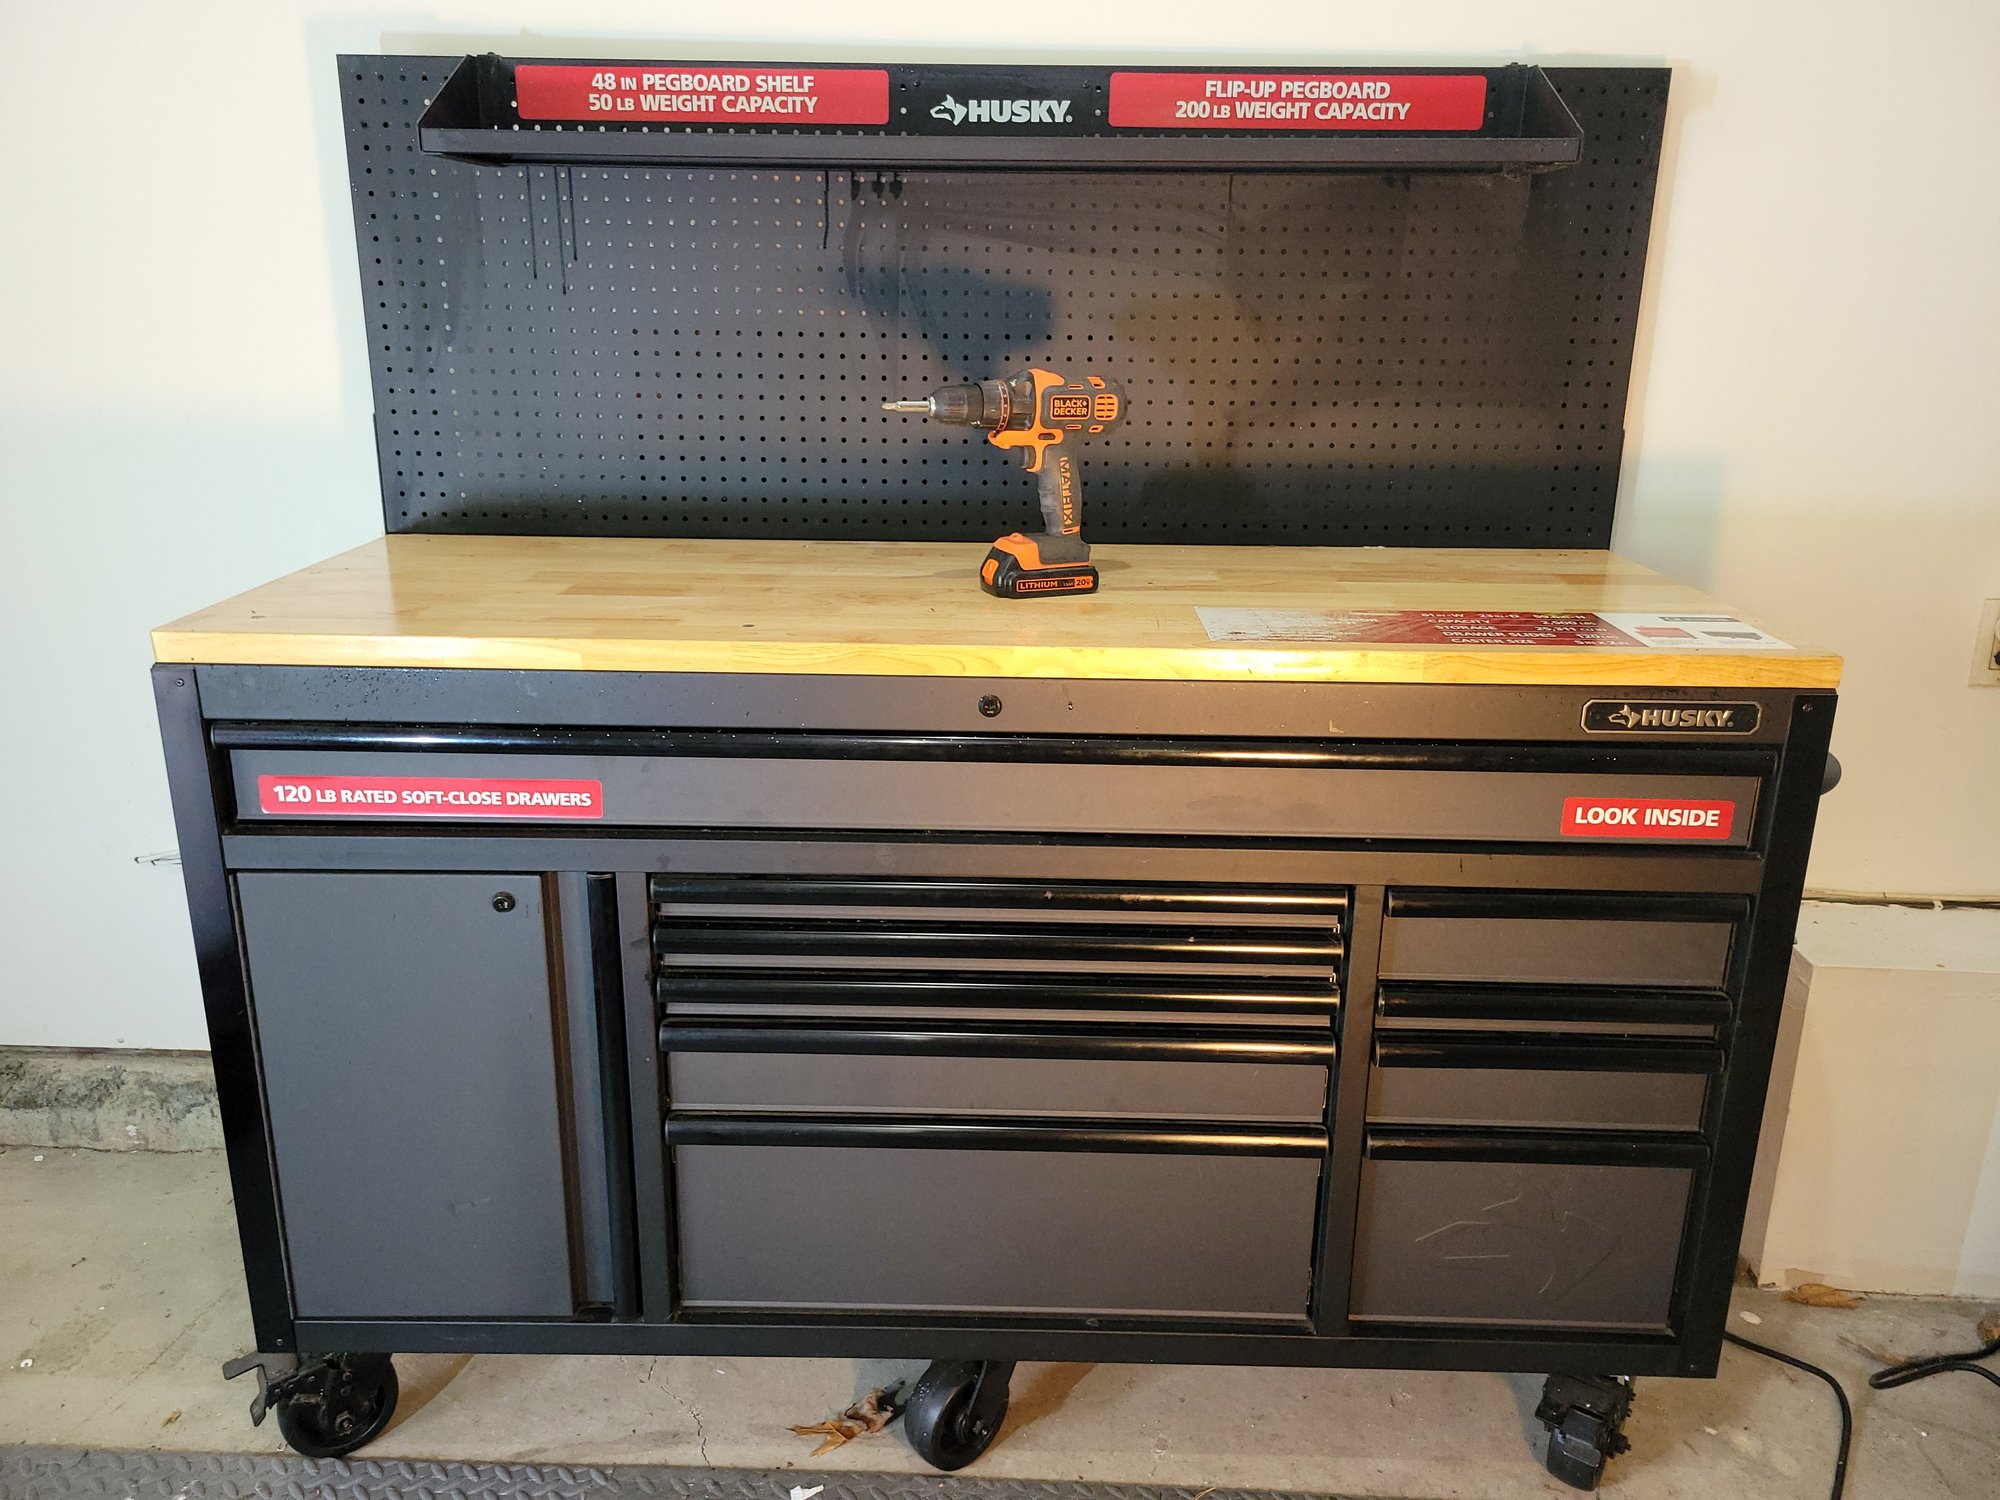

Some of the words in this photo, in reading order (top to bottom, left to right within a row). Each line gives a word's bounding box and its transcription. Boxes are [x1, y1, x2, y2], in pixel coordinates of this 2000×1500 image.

[591, 73, 617, 91] 48
[621, 77, 637, 91] IN
[642, 74, 751, 92] PEGBOARD
[755, 75, 815, 93] SHELF
[1205, 80, 1277, 98] FLIP-UP
[1281, 81, 1391, 100] PEGBOARD
[589, 93, 613, 111] 50
[617, 98, 635, 111] LB
[639, 94, 717, 112] WEIGHT
[722, 96, 818, 114] CAPACITY
[1175, 101, 1211, 118] 200
[1213, 105, 1231, 118] LB
[1235, 101, 1311, 119] WEIGHT
[1314, 102, 1411, 120] CAPACITY
[1054, 407, 1088, 416] DECKER
[1020, 581, 1058, 589] LITHIUM
[273, 785, 312, 802] 120
[316, 789, 337, 803] LB
[341, 790, 398, 804] RATED
[401, 790, 502, 806] SOFT-CLOSE
[506, 792, 592, 807] DRAWERS
[1575, 806, 1639, 825] LOOK
[1644, 808, 1721, 827] INSIDE
